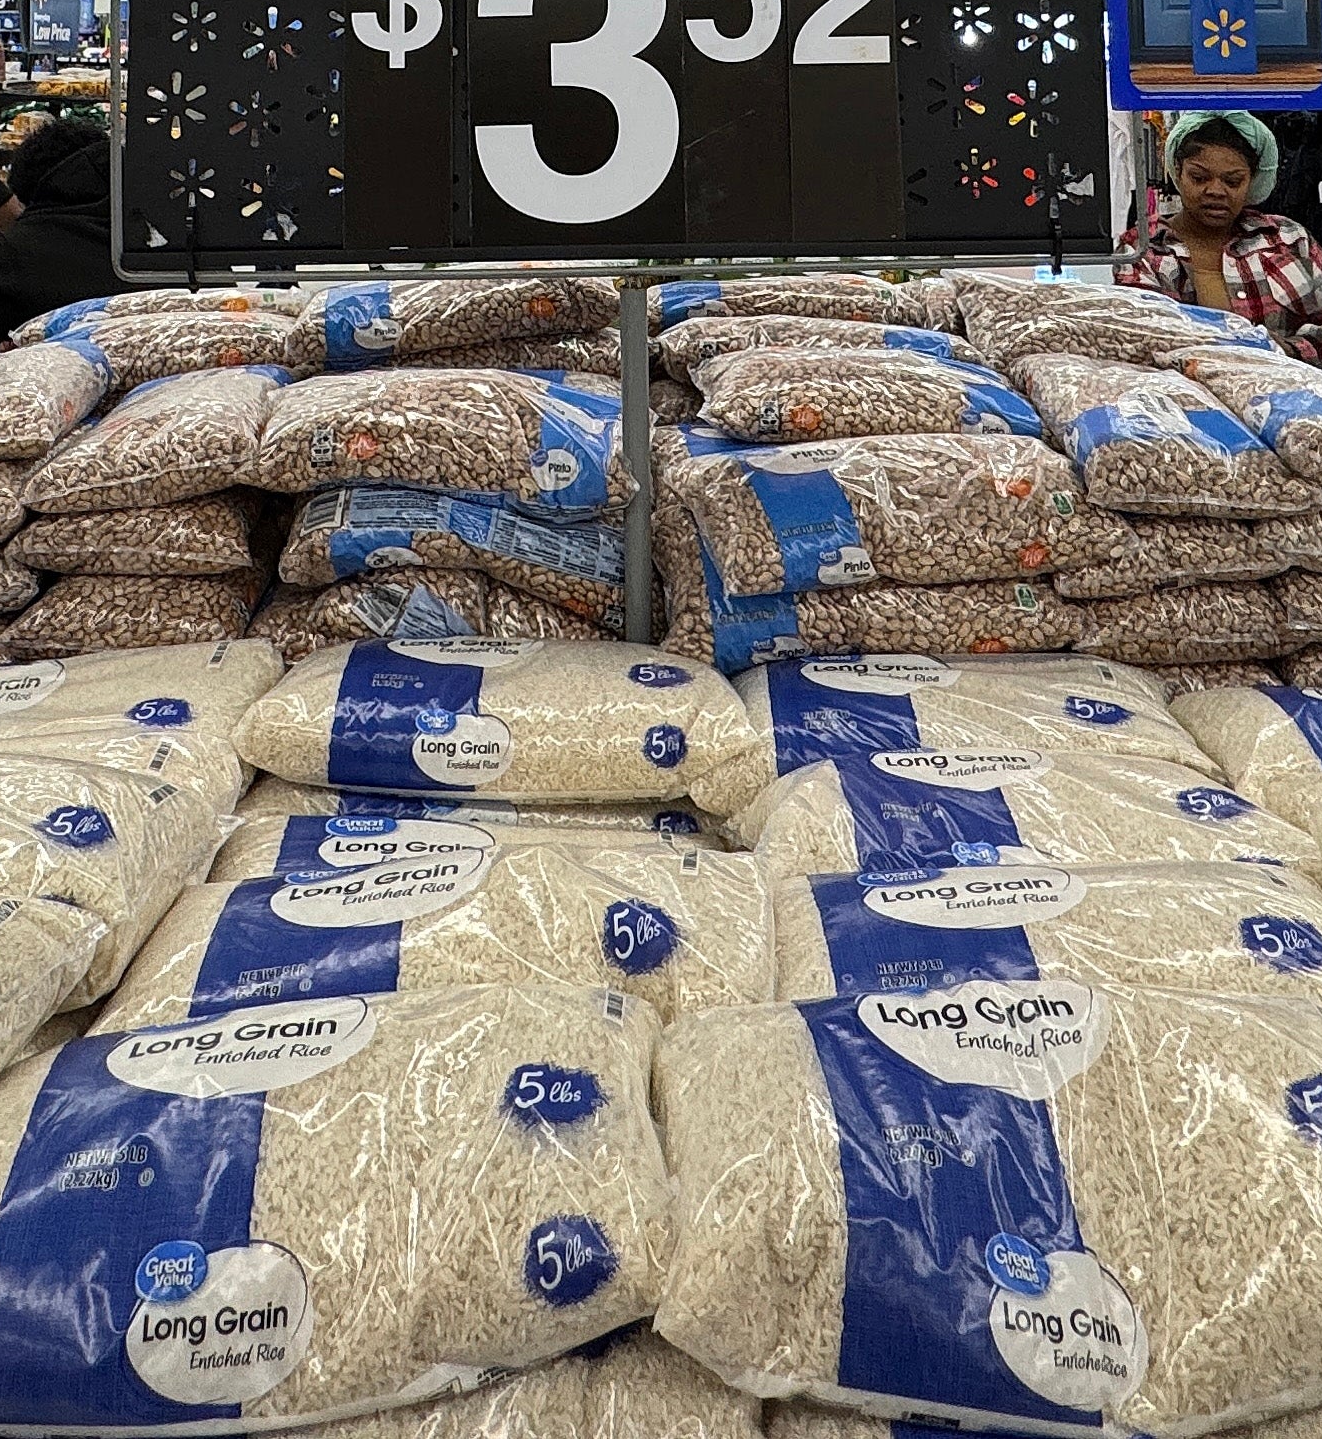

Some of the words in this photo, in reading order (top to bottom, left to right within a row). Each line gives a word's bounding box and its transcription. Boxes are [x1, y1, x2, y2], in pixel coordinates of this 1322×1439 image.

[34, 23, 51, 41] Low
[52, 23, 70, 42] Price
[374, 326, 397, 336] Pinto
[548, 463, 571, 474] Pinto
[844, 559, 870, 573] Pinto
[420, 739, 456, 756] Long
[460, 740, 500, 755] Grain
[289, 879, 365, 901] Long
[374, 863, 459, 885] Grain
[881, 885, 957, 904] Long
[966, 878, 1053, 893] Grain
[877, 1002, 968, 1029] Long
[975, 995, 1074, 1028] Grain
[129, 1029, 223, 1059] Long
[235, 1018, 337, 1041] Grain
[955, 1031, 1039, 1059] Enriched
[1040, 1028, 1083, 1051] Rice
[194, 1044, 286, 1066] Enriched
[289, 1043, 333, 1058] Rice
[145, 1253, 197, 1277] Great
[142, 1313, 206, 1345] Long
[215, 1301, 288, 1335] Grain
[190, 1344, 253, 1370] Enriched
[256, 1343, 286, 1362] Rice
